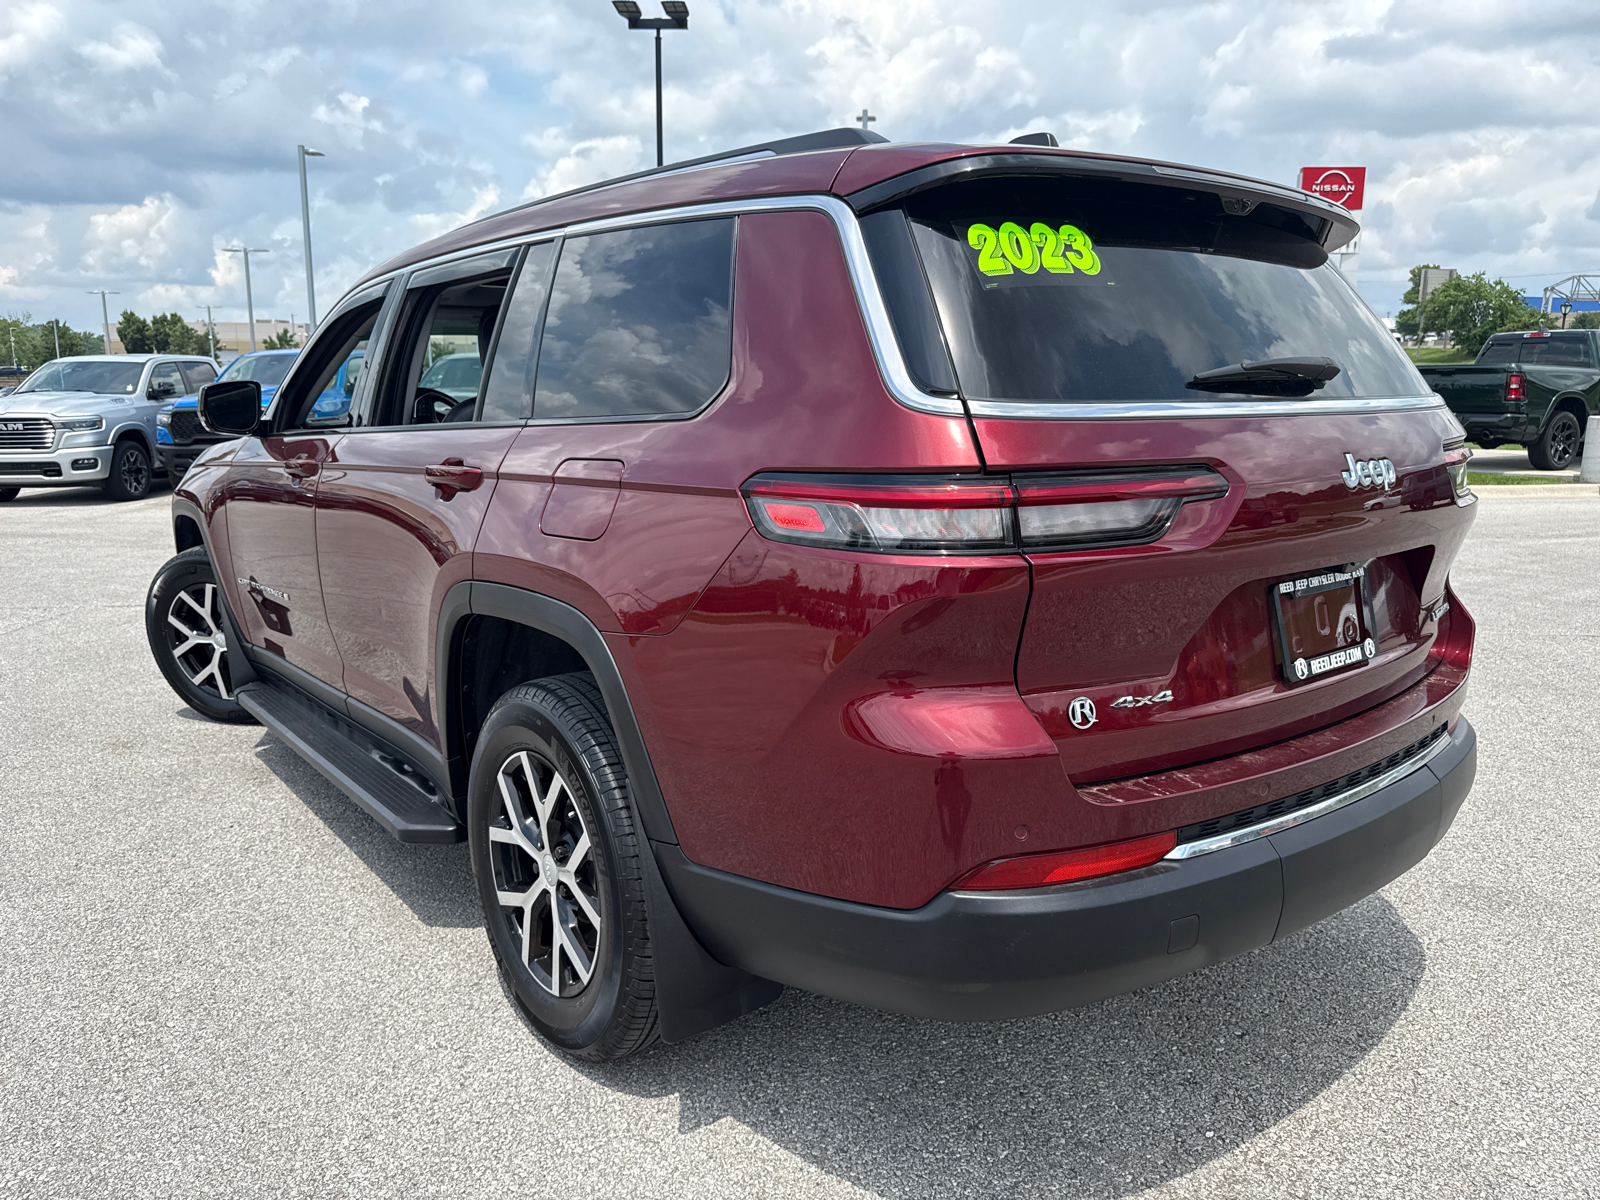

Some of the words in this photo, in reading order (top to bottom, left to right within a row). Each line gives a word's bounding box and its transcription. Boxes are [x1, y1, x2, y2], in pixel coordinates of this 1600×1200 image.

[1312, 184, 1355, 192] NISSAN
[967, 221, 1101, 277] 2023
[0, 423, 24, 431] AM
[1341, 452, 1396, 491] Jeep
[1279, 581, 1294, 594] REED
[1295, 578, 1308, 591] JEEP
[1308, 573, 1335, 588] CHRYSLER
[1310, 646, 1363, 675] REEDJEEP.COM
[569, 773, 606, 873] MICHELIN
